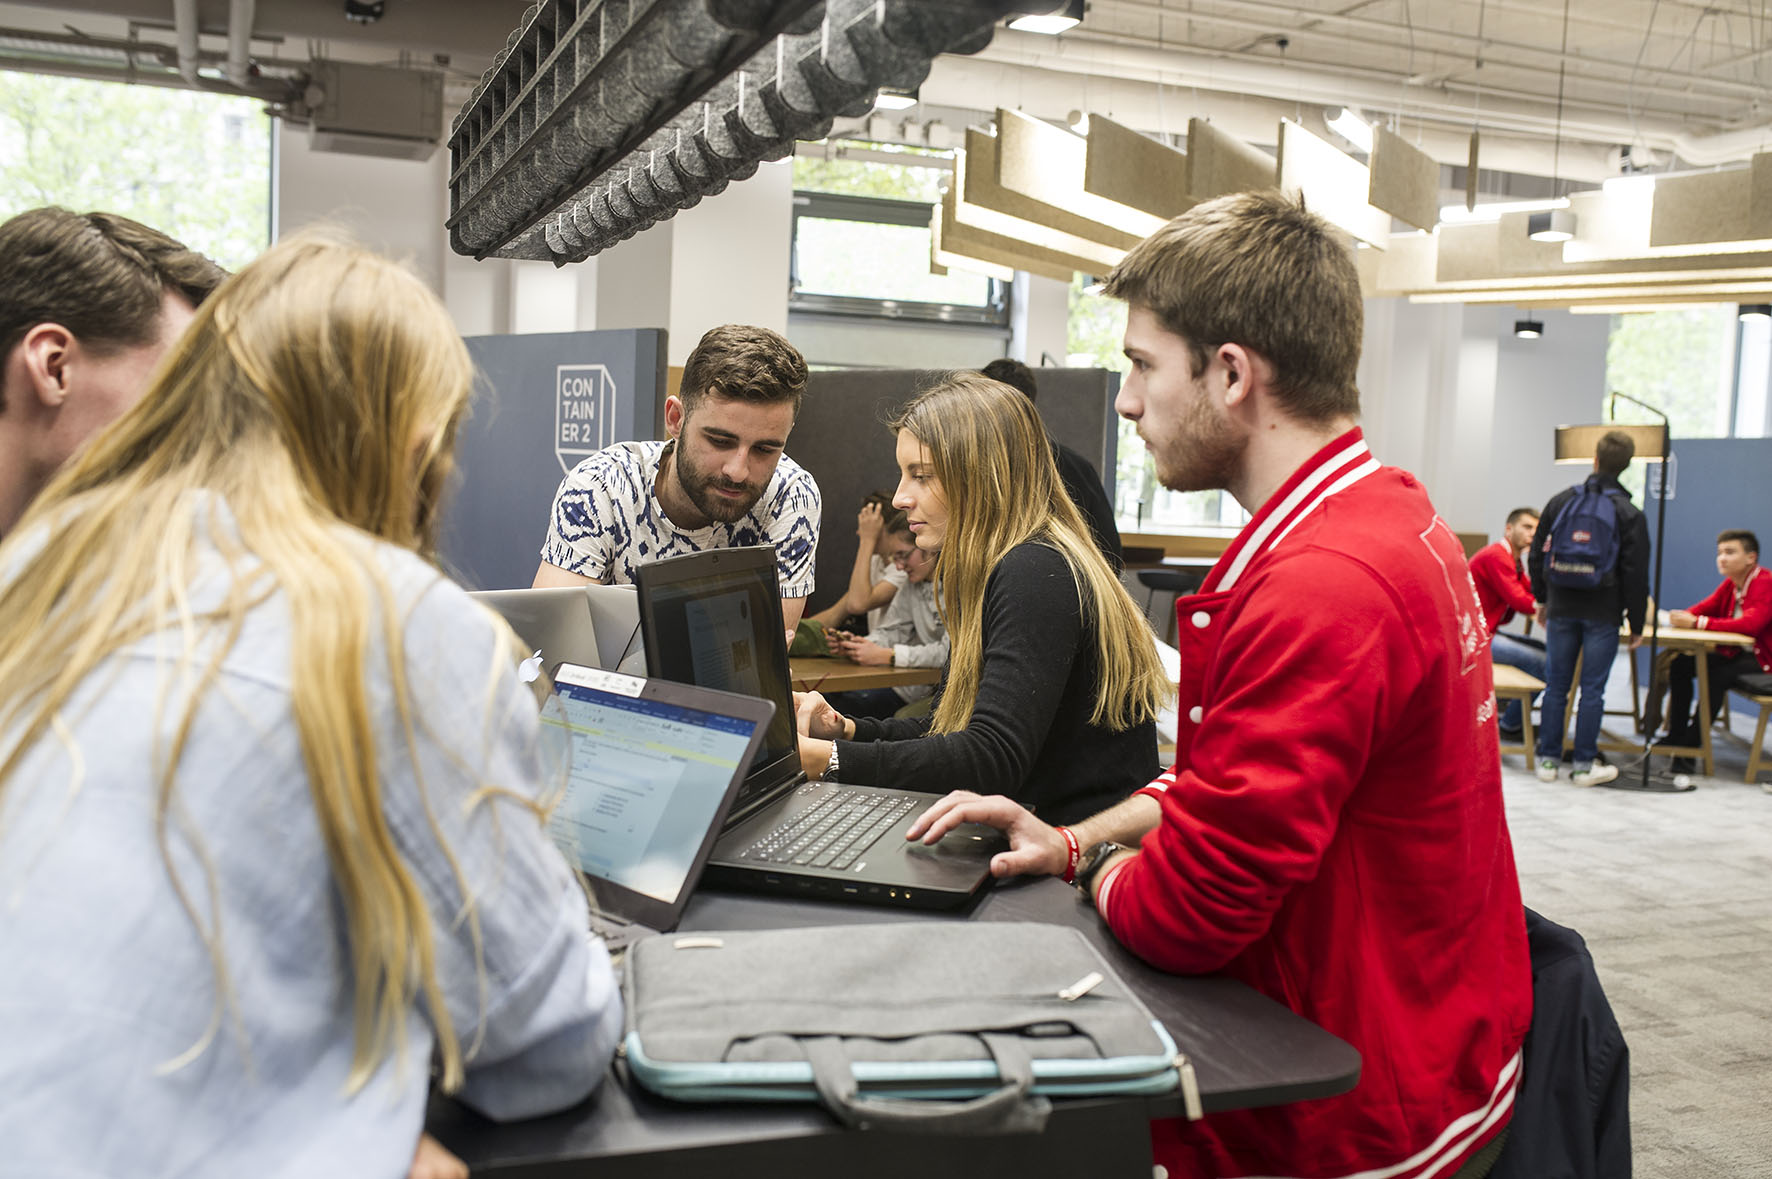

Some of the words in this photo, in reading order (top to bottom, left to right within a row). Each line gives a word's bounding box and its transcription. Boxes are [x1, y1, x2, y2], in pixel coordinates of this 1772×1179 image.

[562, 378, 593, 397] CON
[562, 401, 595, 420] TAIN
[561, 422, 579, 442] ER
[581, 423, 591, 443] 2
